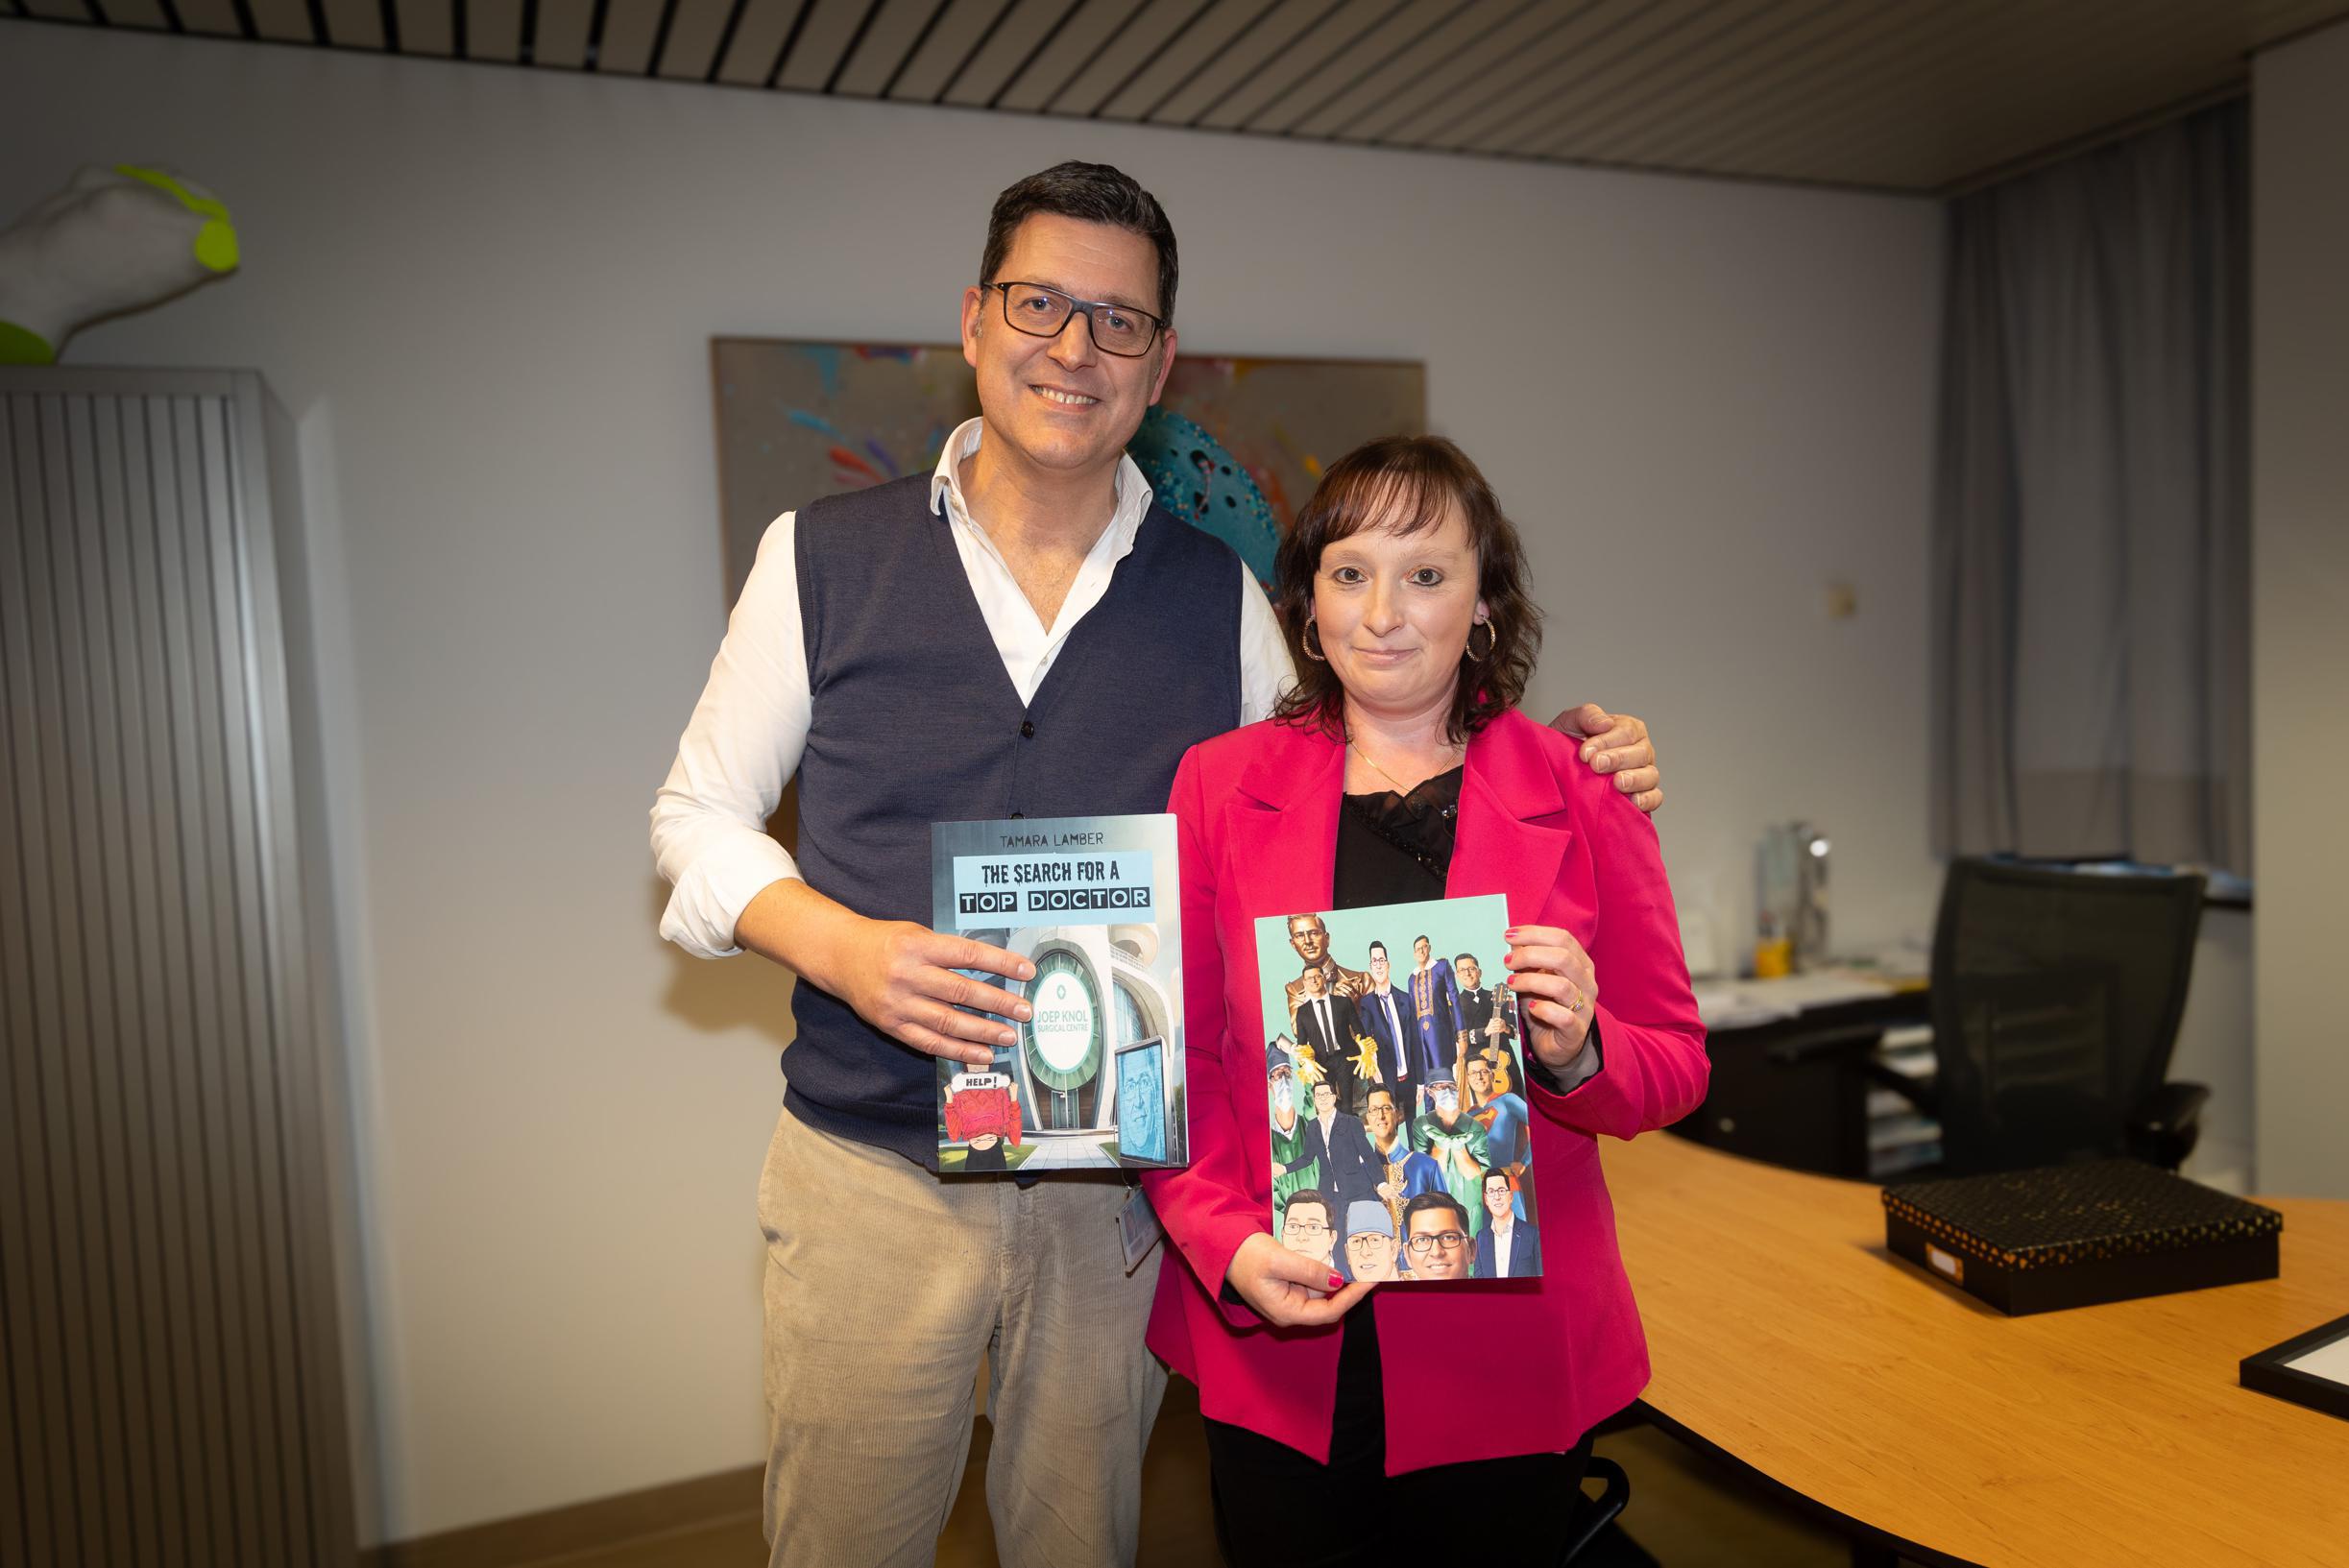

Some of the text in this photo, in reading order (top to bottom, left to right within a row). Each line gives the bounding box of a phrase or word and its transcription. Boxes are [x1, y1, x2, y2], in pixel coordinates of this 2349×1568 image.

[1000, 832, 1103, 848] TAMARA LAMBER
[981, 859, 1120, 885] THE SEARCH FOR A
[960, 888, 1150, 912] TOP DOCTOR
[1037, 1009, 1088, 1023] JOEP KNOL
[1037, 1023, 1089, 1032] SURGICAL CENTRE
[965, 1076, 997, 1088] HELP!
